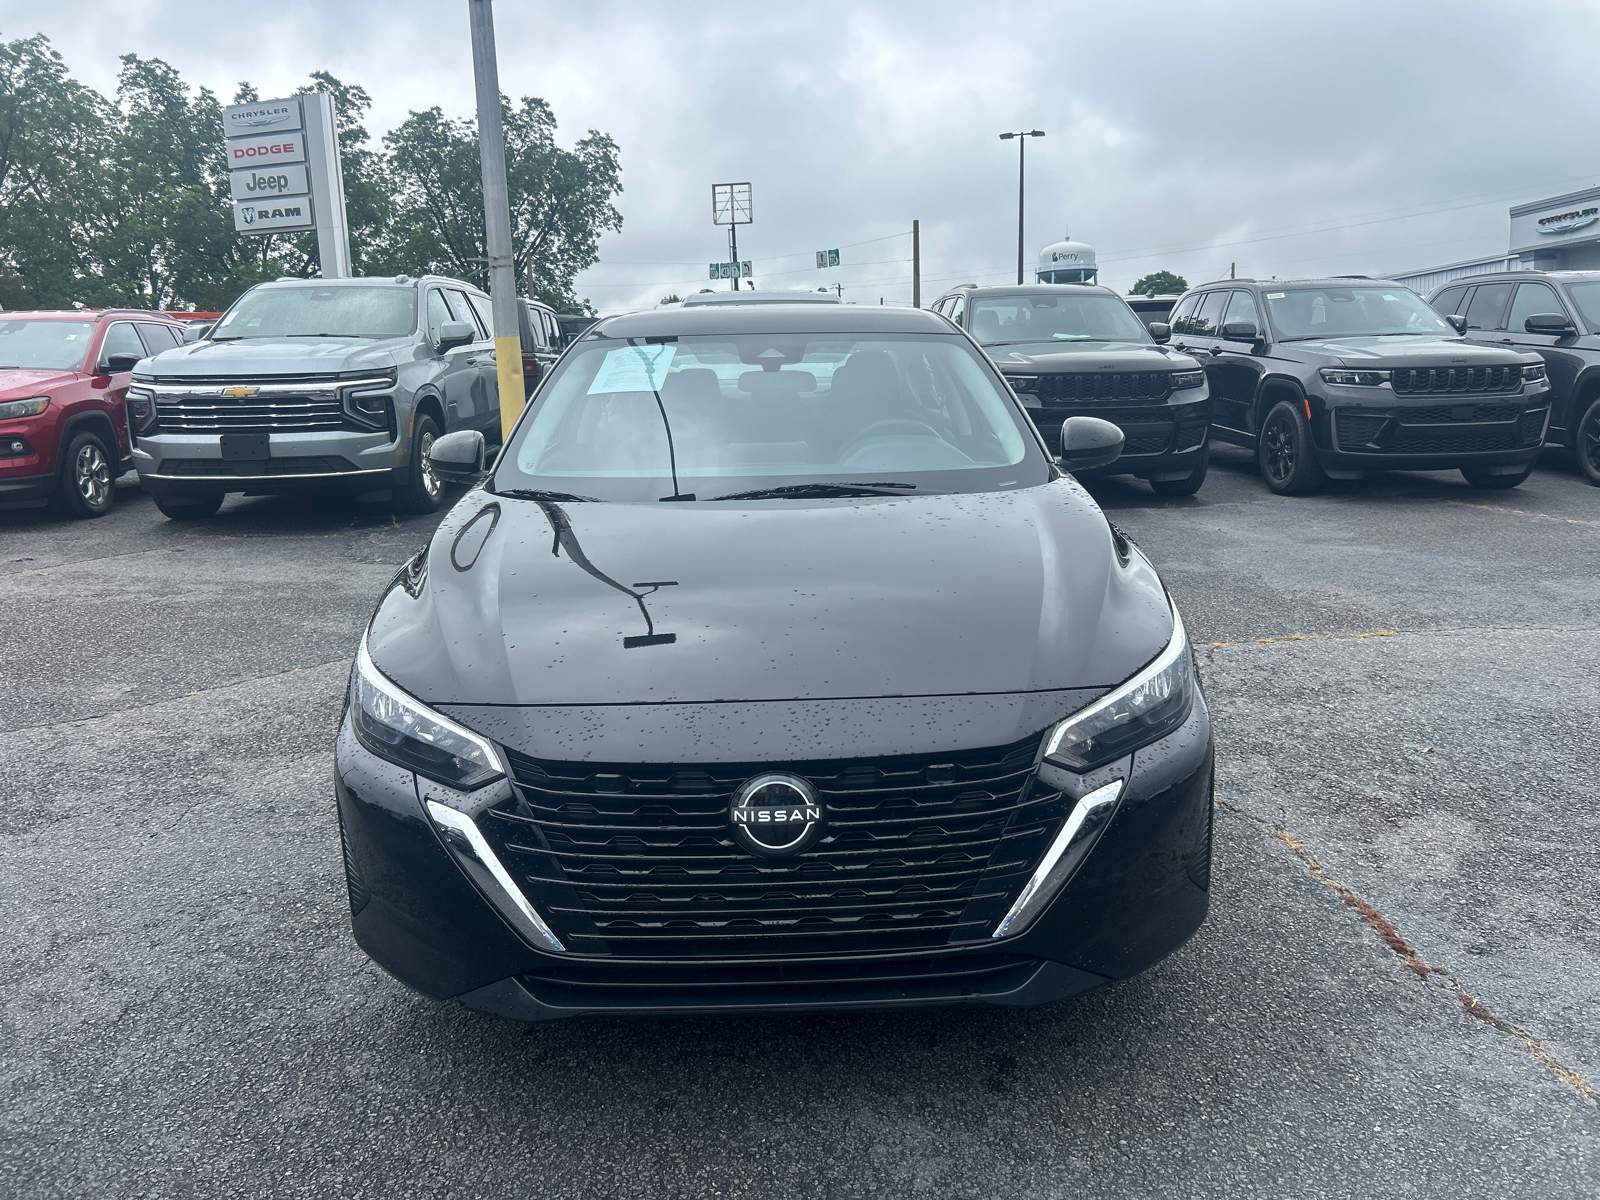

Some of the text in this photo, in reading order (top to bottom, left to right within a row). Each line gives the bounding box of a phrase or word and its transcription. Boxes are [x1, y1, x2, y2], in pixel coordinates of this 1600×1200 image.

[231, 107, 289, 120] CHRYSLER
[234, 143, 295, 159] DODGE
[246, 173, 289, 192] Jeep
[257, 207, 302, 220] RAM
[1058, 252, 1079, 261] Perry
[733, 807, 820, 822] NISSAN
